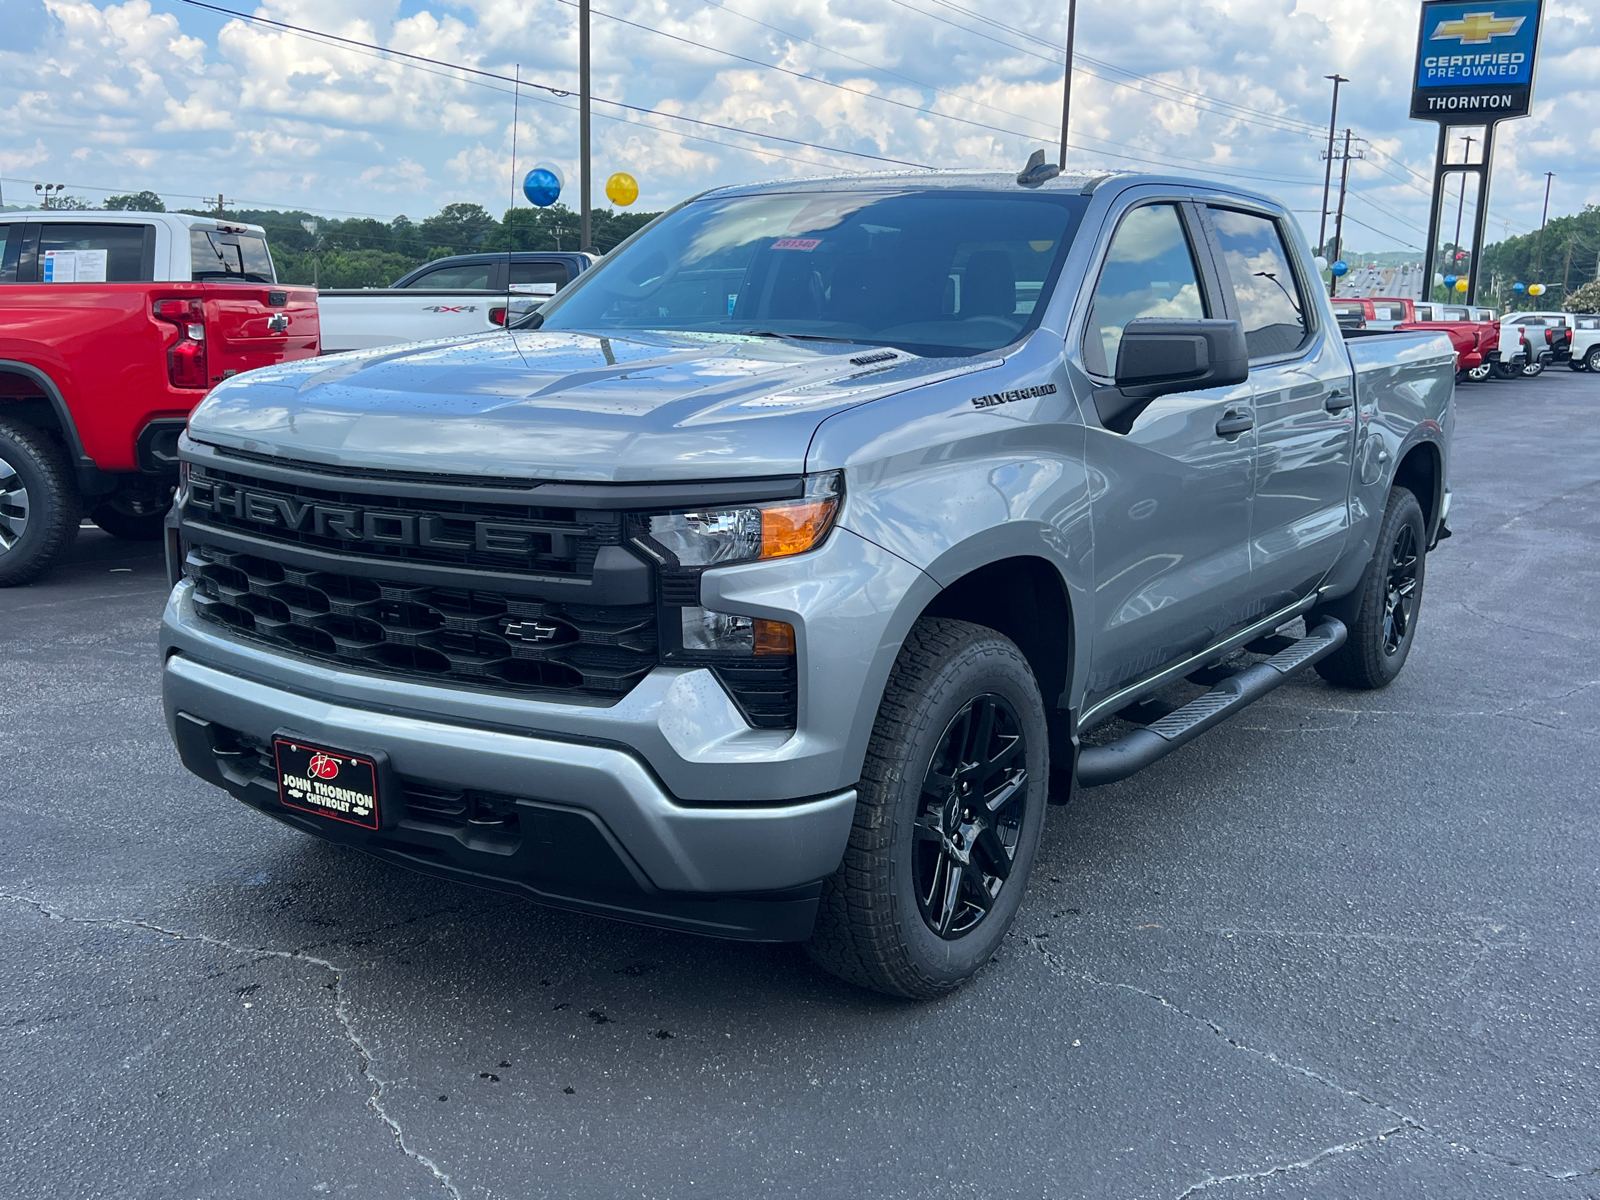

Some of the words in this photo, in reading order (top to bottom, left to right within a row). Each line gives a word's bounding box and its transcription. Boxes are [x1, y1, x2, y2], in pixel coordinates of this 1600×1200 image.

[1424, 52, 1525, 67] CERTIFIED
[1427, 64, 1518, 78] PRE-OWNED
[1427, 94, 1512, 110] THORNTON
[971, 383, 1057, 409] SILVERADO
[187, 476, 595, 558] CHEVROLET
[282, 773, 312, 793] JOHN
[313, 781, 374, 809] THORNTON
[306, 792, 350, 813] CHEVROLET
